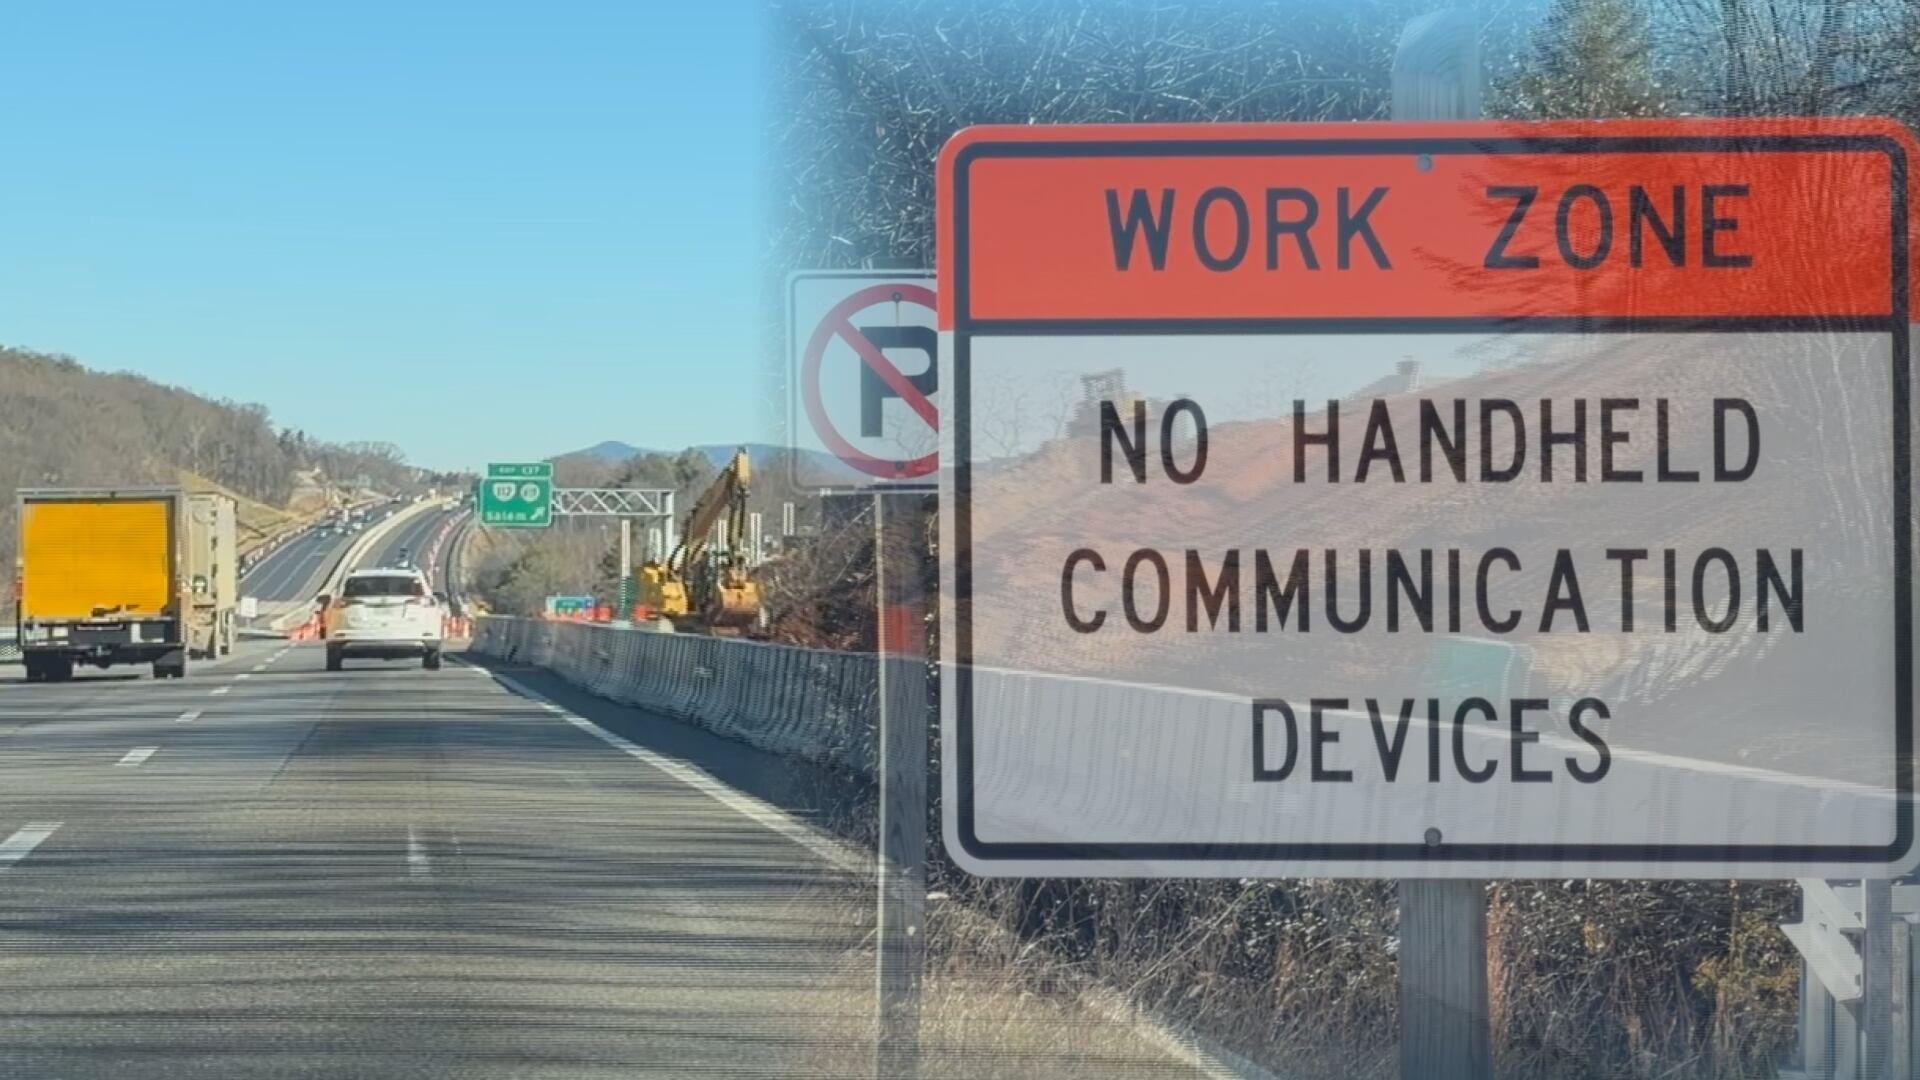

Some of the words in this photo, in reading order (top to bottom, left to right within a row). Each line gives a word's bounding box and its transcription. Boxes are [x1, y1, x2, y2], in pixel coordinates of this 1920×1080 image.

[1106, 187, 1391, 271] WORK
[1484, 184, 1753, 270] ZONE
[860, 326, 939, 437] P
[1101, 399, 1208, 483] NO
[1294, 398, 1760, 483] HANDHELD
[487, 511, 527, 520] Salem
[1062, 547, 1804, 633] COMMUNICATION
[1253, 697, 1612, 783] DEVICES
